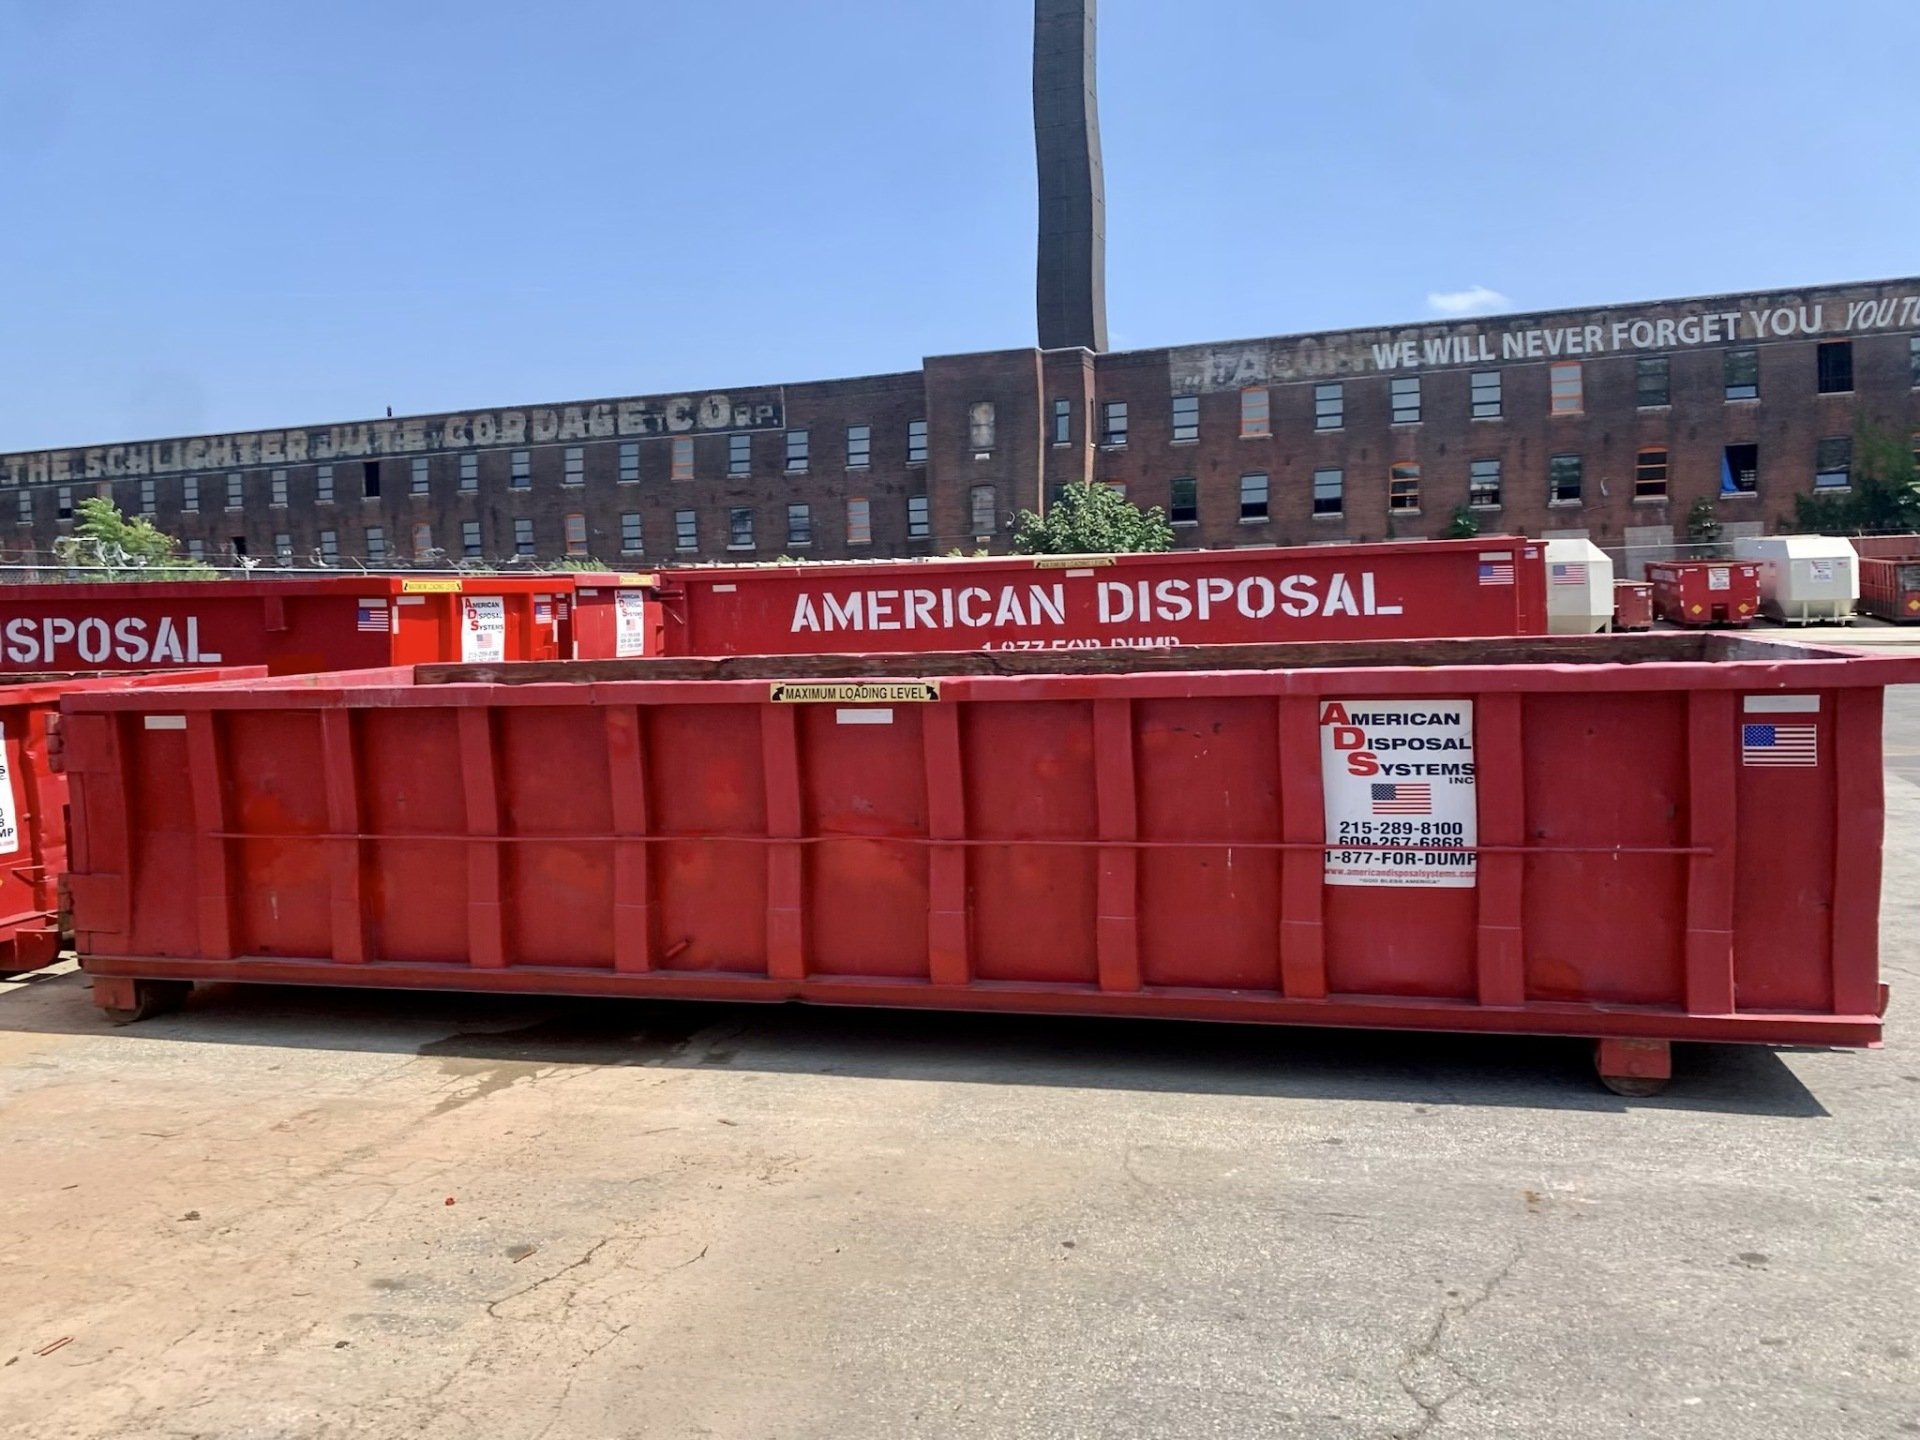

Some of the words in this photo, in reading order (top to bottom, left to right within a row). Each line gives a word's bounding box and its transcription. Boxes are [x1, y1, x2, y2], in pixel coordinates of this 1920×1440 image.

[1845, 298, 1898, 330] YOU
[1372, 340, 1418, 370] WE
[1423, 334, 1496, 366] WILL
[1502, 324, 1604, 359] NEVER
[1611, 311, 1741, 350] FORGET
[1750, 304, 1822, 338] YOU
[1, 452, 71, 484] THE
[443, 401, 645, 448] CORDAGE
[465, 598, 500, 609] AMERICAN
[791, 584, 1065, 633] AMERICAN
[1096, 571, 1403, 625] DISPOSAL
[470, 620, 504, 631] SYSTEMS
[0, 616, 222, 663] SPOSAL
[785, 687, 836, 700] MAXIMUM
[839, 687, 887, 700] LOADING
[890, 687, 925, 699] LEVEL
[1320, 702, 1460, 727] AMERICAN
[1334, 726, 1472, 751] DISPOSAL
[1347, 751, 1475, 777] SYSTEMS
[1449, 776, 1474, 785] INC
[1339, 820, 1463, 836] 215-289-8100
[1339, 835, 1463, 848] 609-267-6868
[1324, 850, 1477, 866] 1-877-FOR-DUMP
